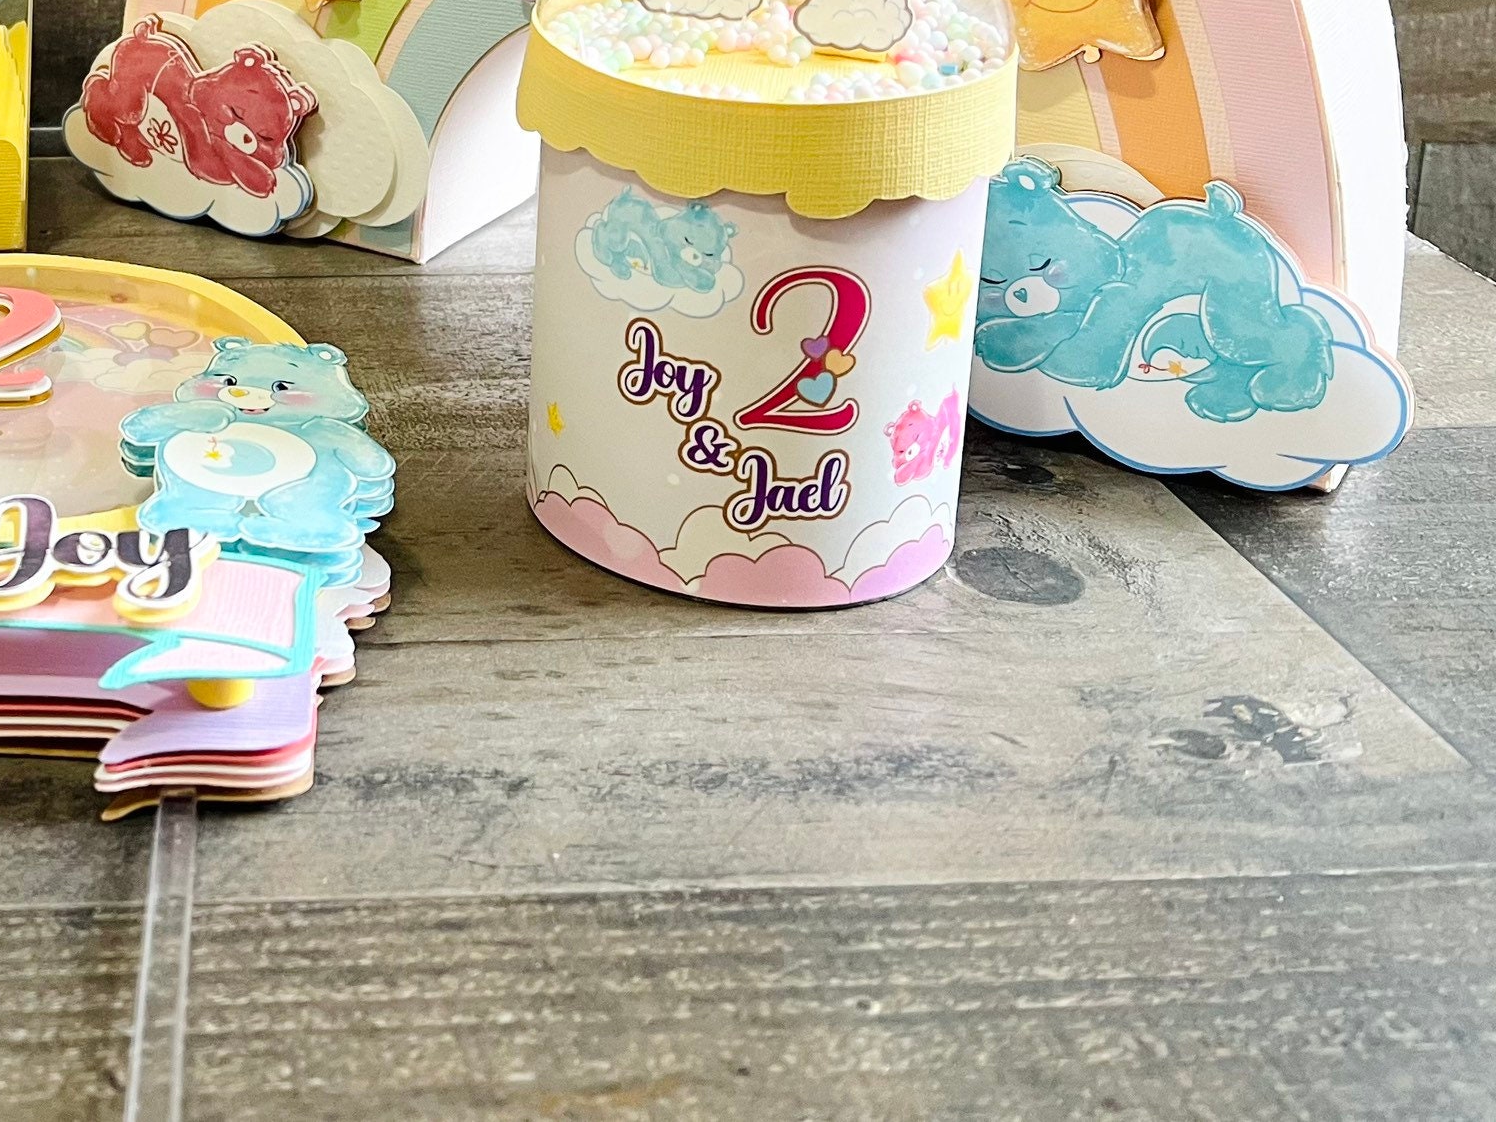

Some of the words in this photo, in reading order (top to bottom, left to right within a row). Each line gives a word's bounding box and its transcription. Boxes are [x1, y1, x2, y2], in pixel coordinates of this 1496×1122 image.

[620, 322, 716, 420] Joy
[733, 265, 872, 436] 2
[683, 424, 739, 472] &
[729, 452, 848, 528] Jael
